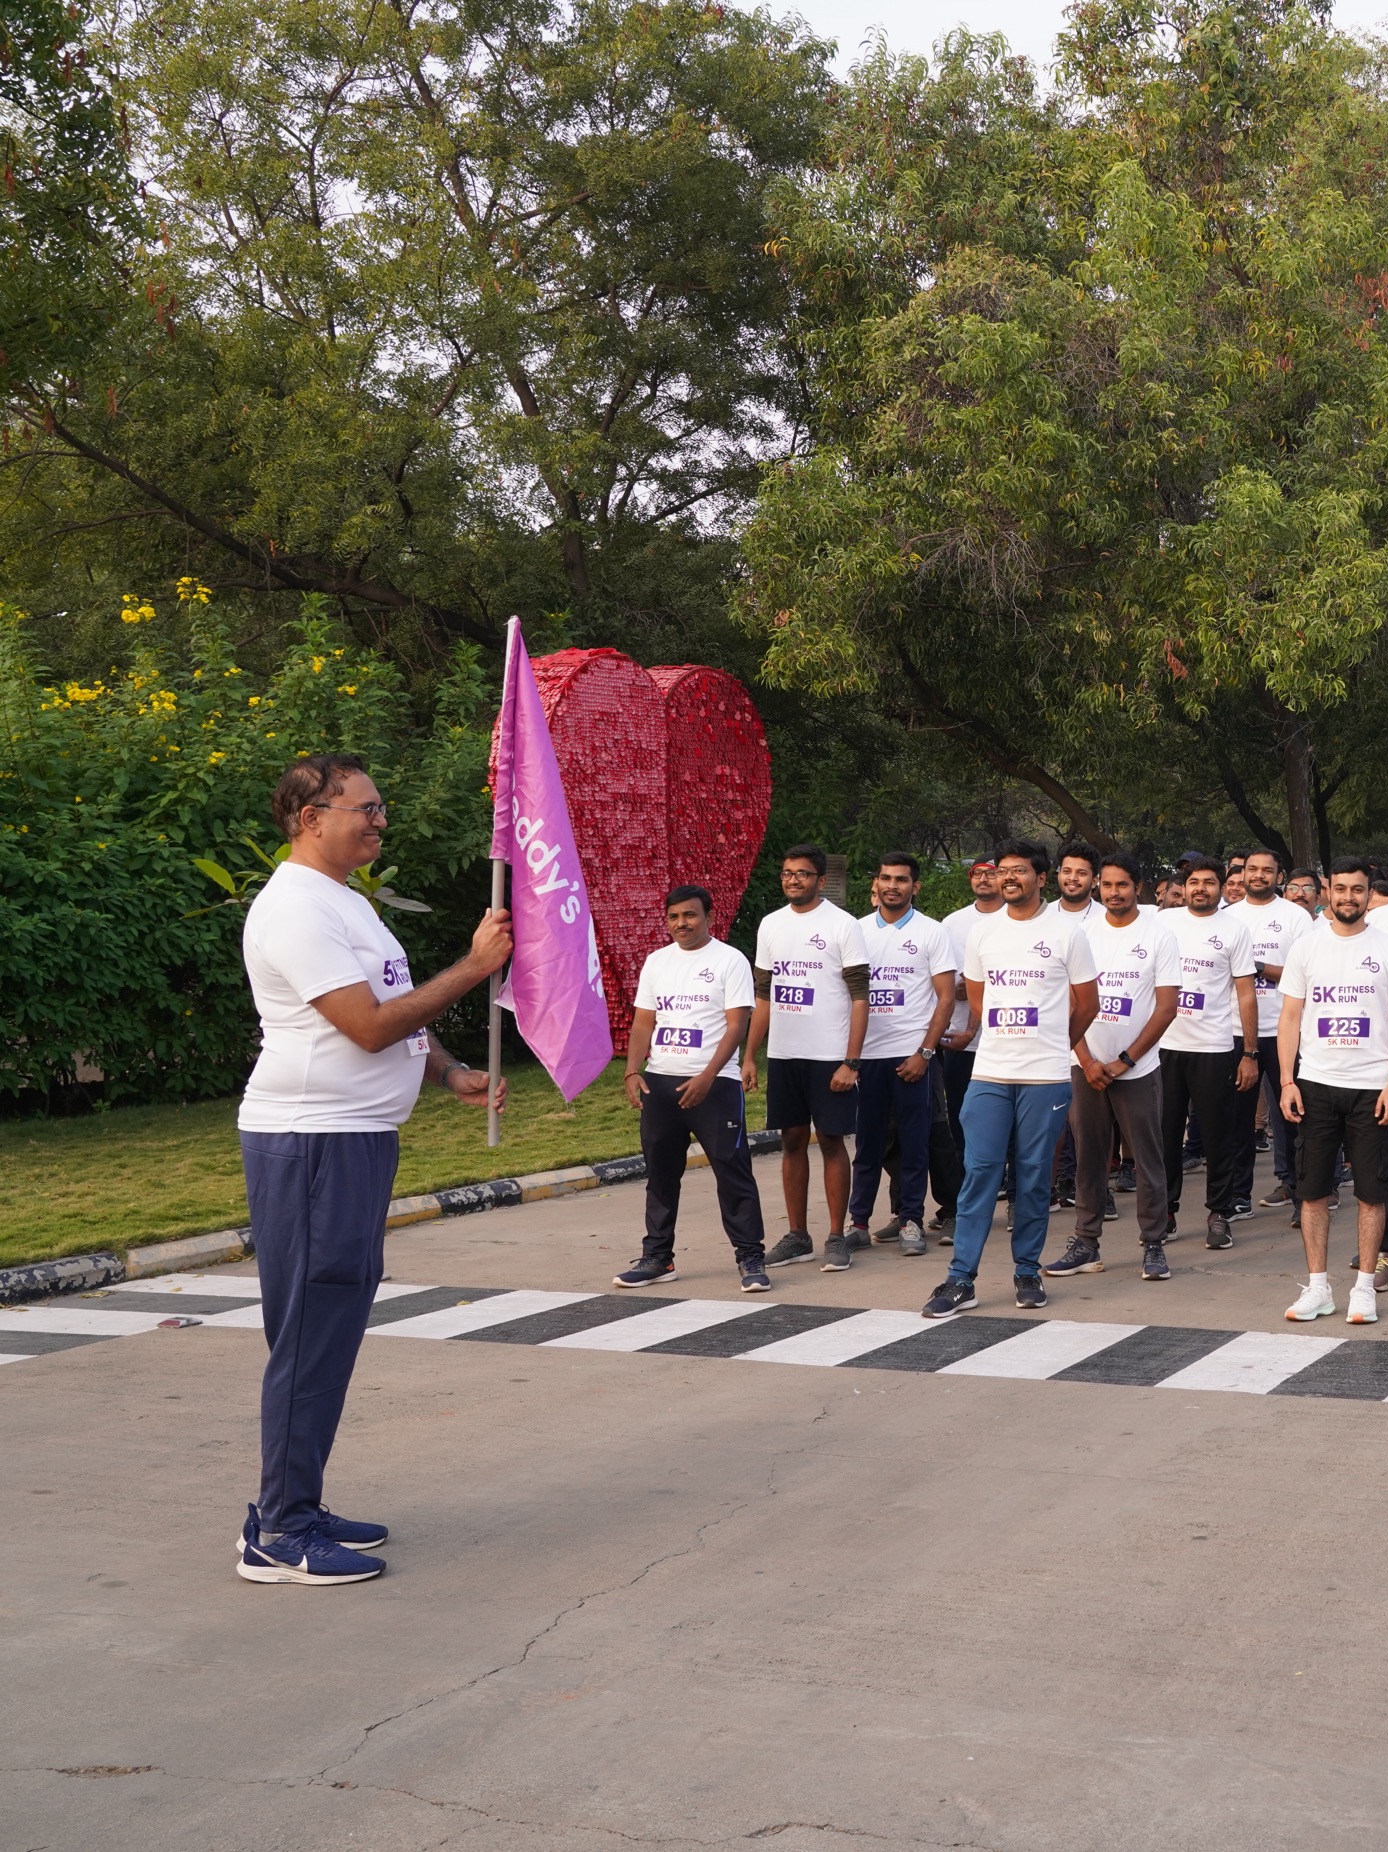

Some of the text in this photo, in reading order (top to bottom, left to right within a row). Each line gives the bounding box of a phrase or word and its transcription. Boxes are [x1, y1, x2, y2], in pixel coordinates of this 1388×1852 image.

[512, 787, 581, 924] eddy's
[772, 961, 823, 976] 5K FITNESS
[1184, 958, 1215, 968] FITNESS
[869, 966, 915, 980] K FITNESS
[987, 970, 1045, 986] 5K FITNESS
[1096, 971, 1140, 986] K FITNESS
[779, 987, 804, 1003] 218
[869, 991, 895, 1005] 055
[1178, 992, 1195, 1007] 16
[1312, 986, 1375, 1003] 5K FITNESS
[1338, 995, 1358, 1003] RUN
[656, 994, 710, 1011] 5K FITNESS
[786, 1004, 801, 1012] RUN
[1100, 997, 1122, 1013] 89
[996, 1009, 1027, 1025] 008
[1102, 1014, 1119, 1022] RUN
[1177, 1008, 1192, 1016] RUN
[1008, 1027, 1026, 1035] RUN
[1328, 1019, 1360, 1036] 225
[663, 1029, 691, 1045] 043
[1327, 1038, 1359, 1046] 5K RUN
[671, 1047, 689, 1055] RUN
